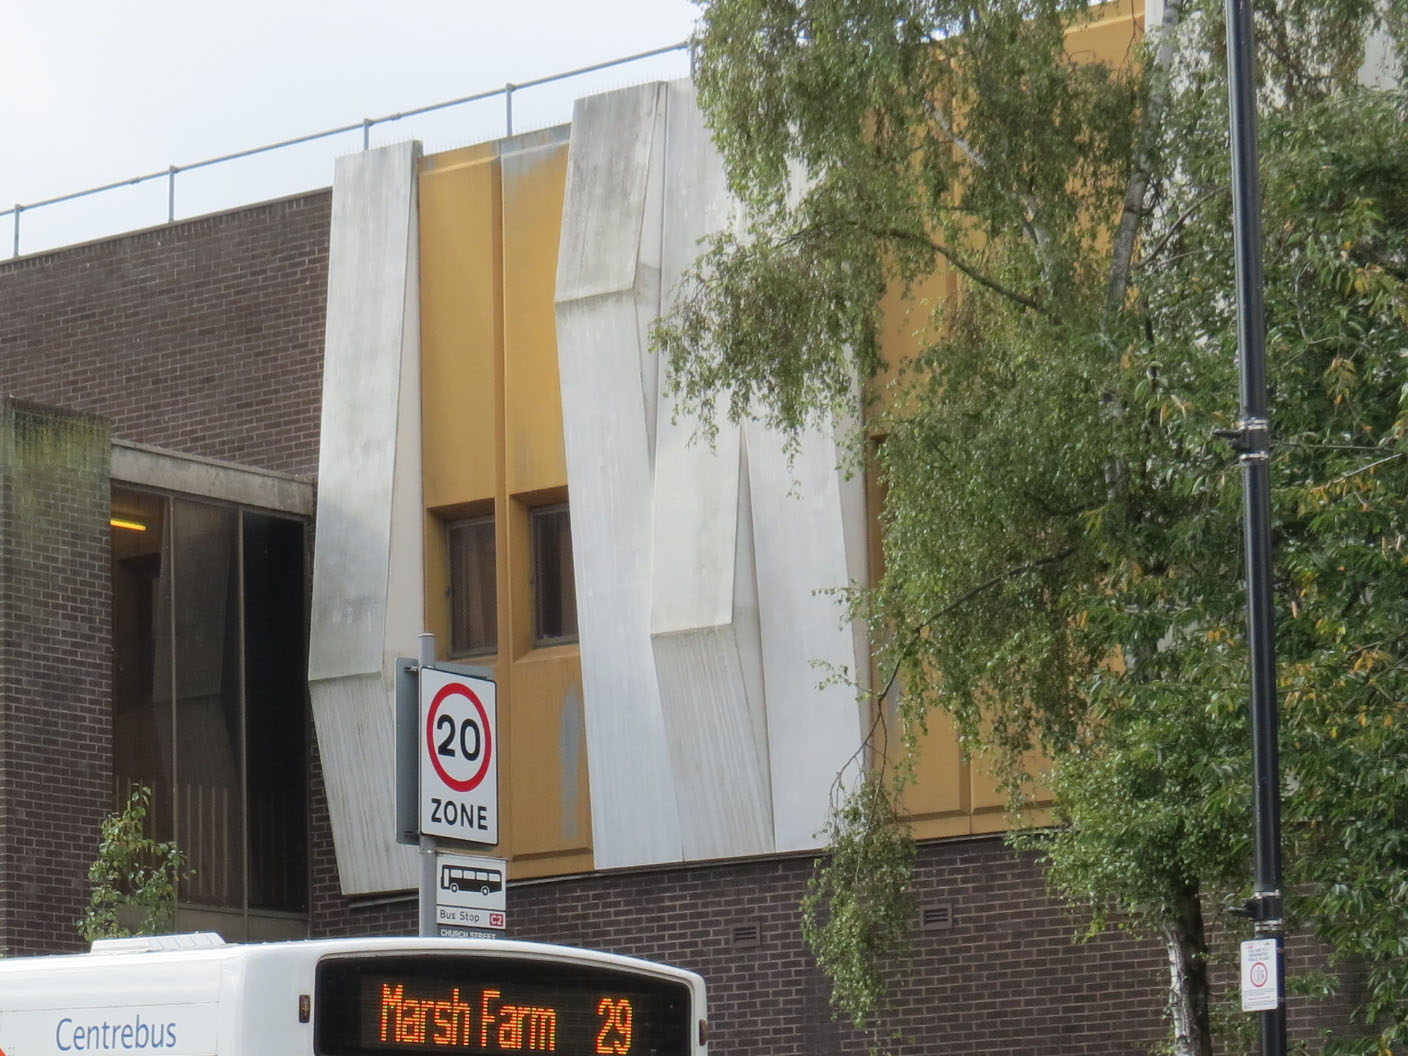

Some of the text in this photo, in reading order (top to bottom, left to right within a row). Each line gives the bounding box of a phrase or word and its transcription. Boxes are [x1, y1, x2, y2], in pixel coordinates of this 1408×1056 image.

[437, 714, 481, 761] 20
[431, 797, 488, 831] ZONE
[440, 909, 503, 926] Bus Stop C2
[440, 928, 497, 940] CHURCH STREET
[56, 1014, 177, 1051] Centrebus
[381, 984, 632, 1055] Marsh Farm 29
